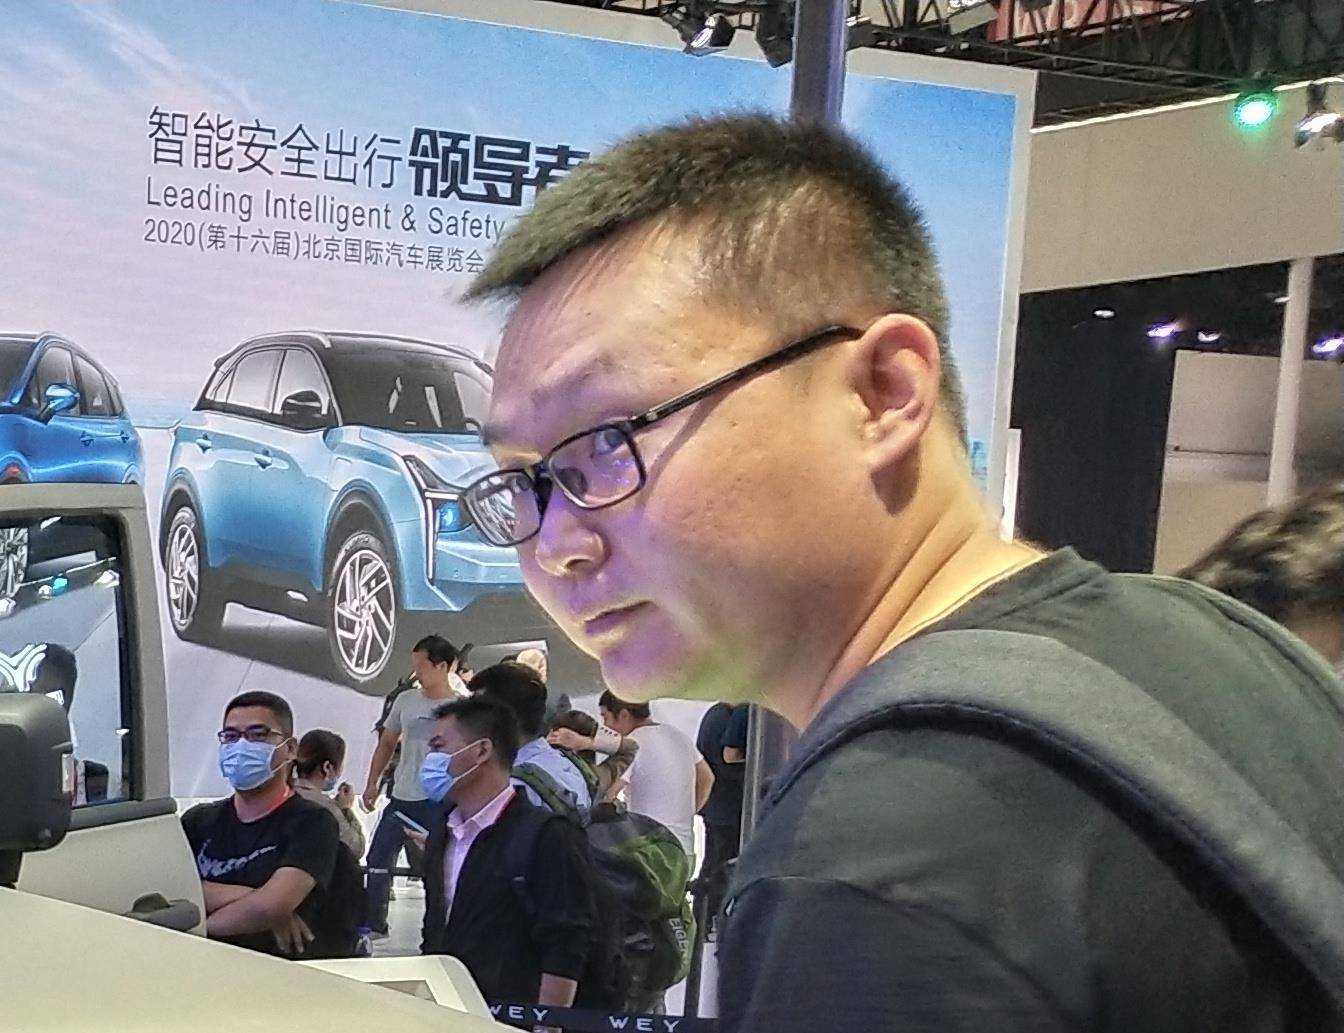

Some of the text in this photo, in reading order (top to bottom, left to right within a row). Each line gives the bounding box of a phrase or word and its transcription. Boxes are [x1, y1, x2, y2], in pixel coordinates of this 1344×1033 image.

[146, 176, 505, 244] Leading Intelligent & Safety
[609, 1015, 680, 1033] WEY
